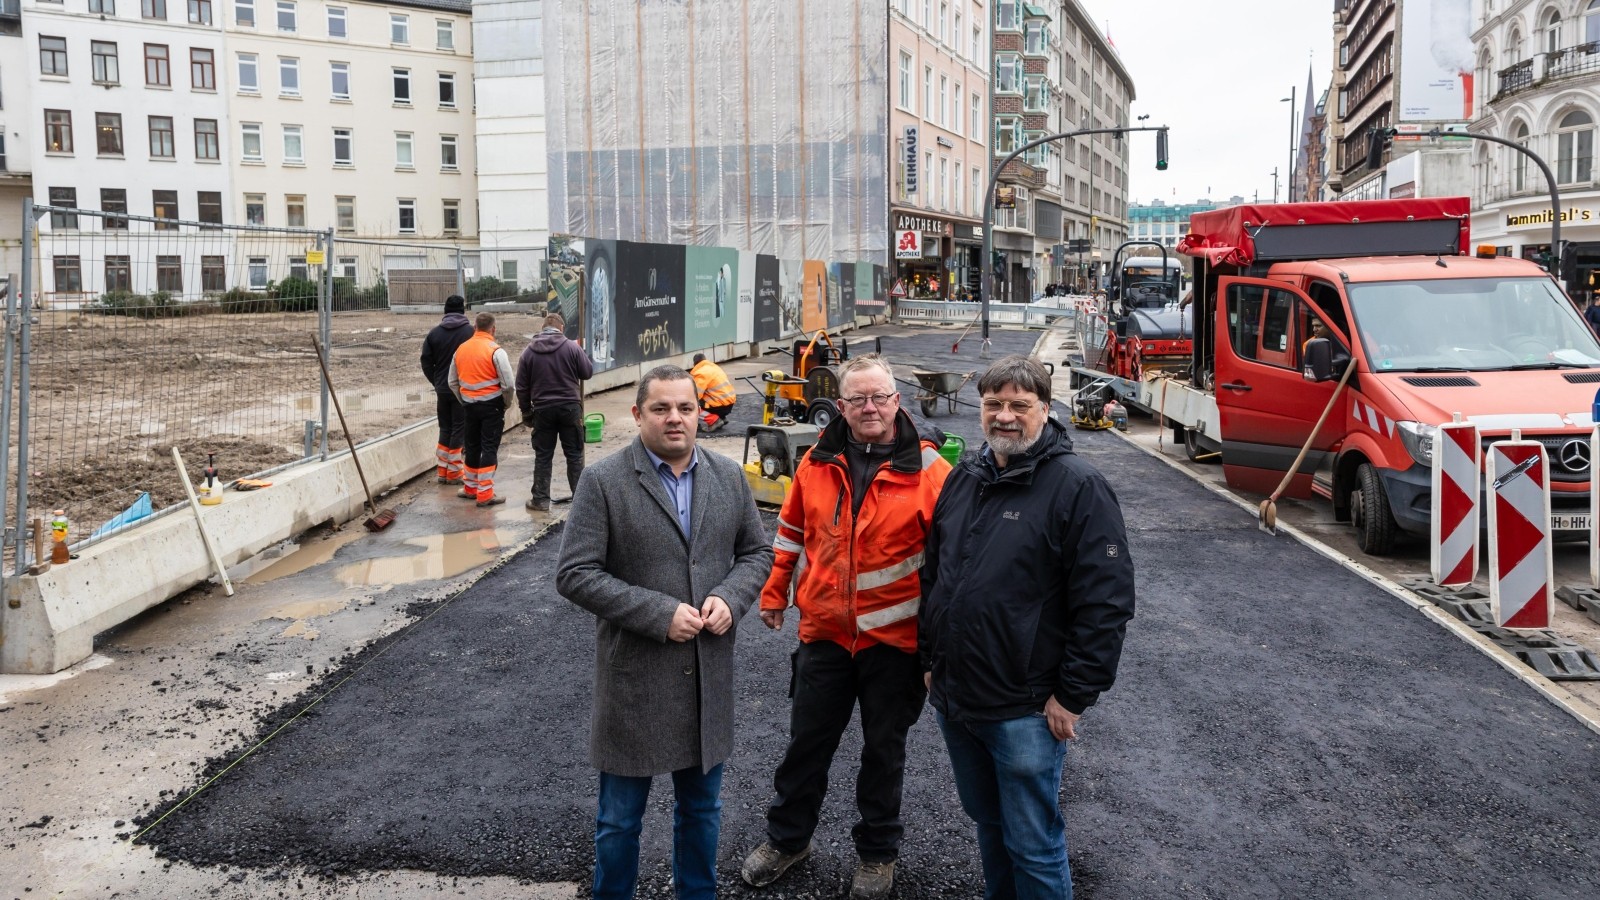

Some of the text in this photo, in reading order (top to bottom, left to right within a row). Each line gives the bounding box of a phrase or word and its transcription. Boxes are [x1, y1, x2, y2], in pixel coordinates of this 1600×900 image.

[907, 128, 916, 193] LEIHHAUS
[899, 215, 942, 233] APOTHEKE
[1571, 516, 1586, 528] HH
